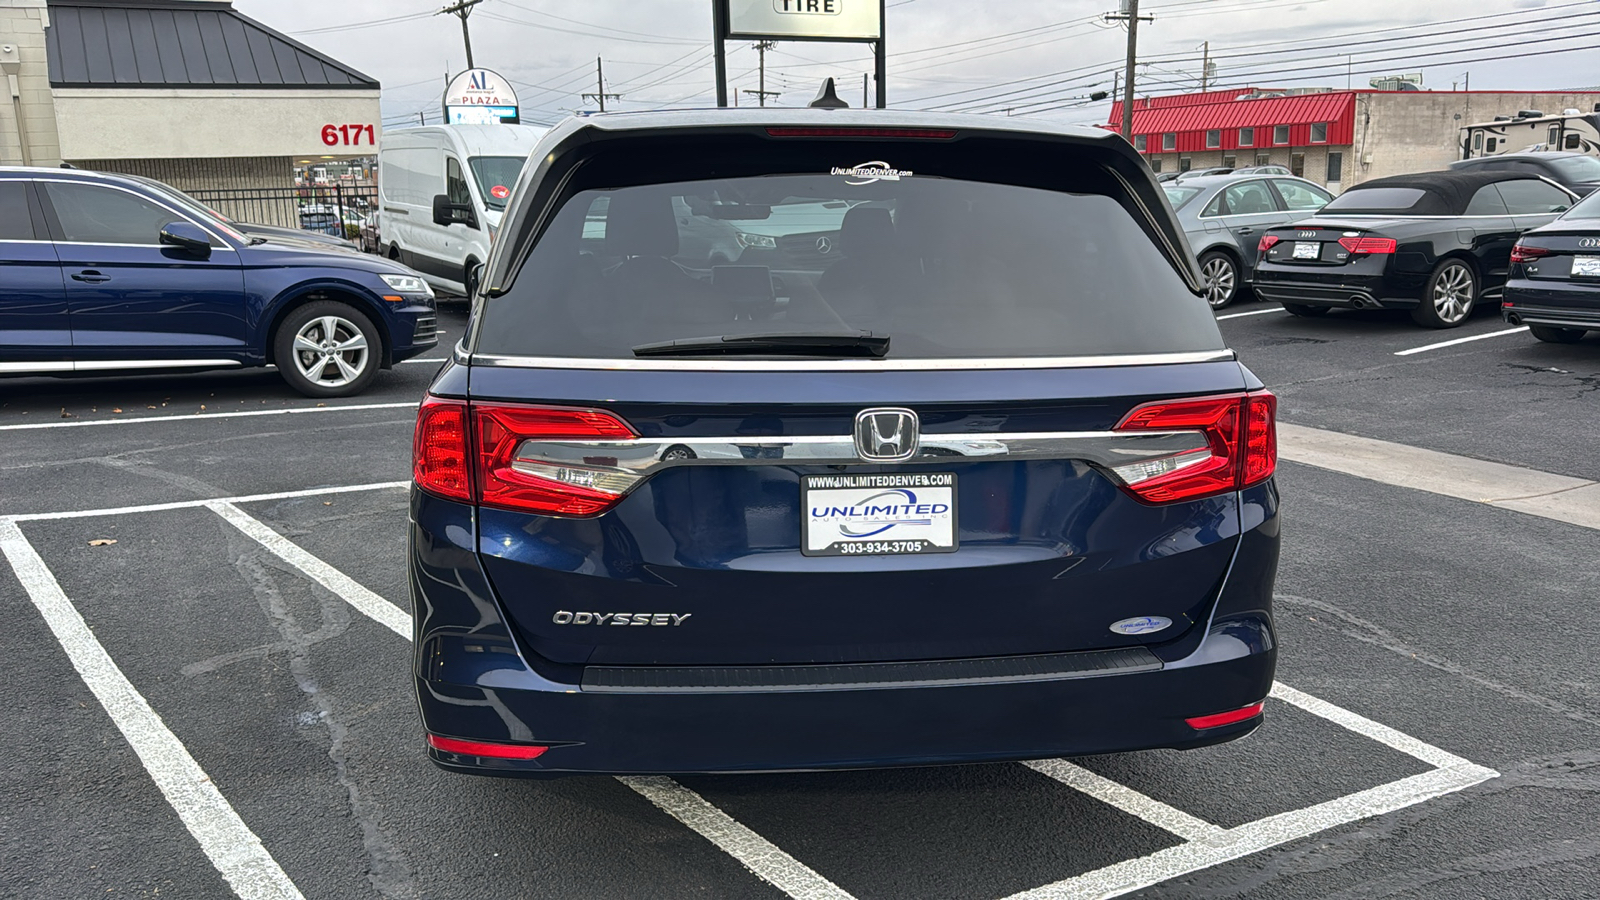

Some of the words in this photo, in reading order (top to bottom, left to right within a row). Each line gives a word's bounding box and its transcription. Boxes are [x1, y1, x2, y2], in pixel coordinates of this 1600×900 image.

[780, 0, 835, 12] TIRE
[467, 71, 494, 90] AL
[462, 96, 500, 105] PLAZA
[321, 124, 375, 146] 6171
[812, 503, 949, 517] UNLIMITED
[840, 541, 922, 554] 303-934-3705
[552, 610, 692, 626] ODYSSEY
